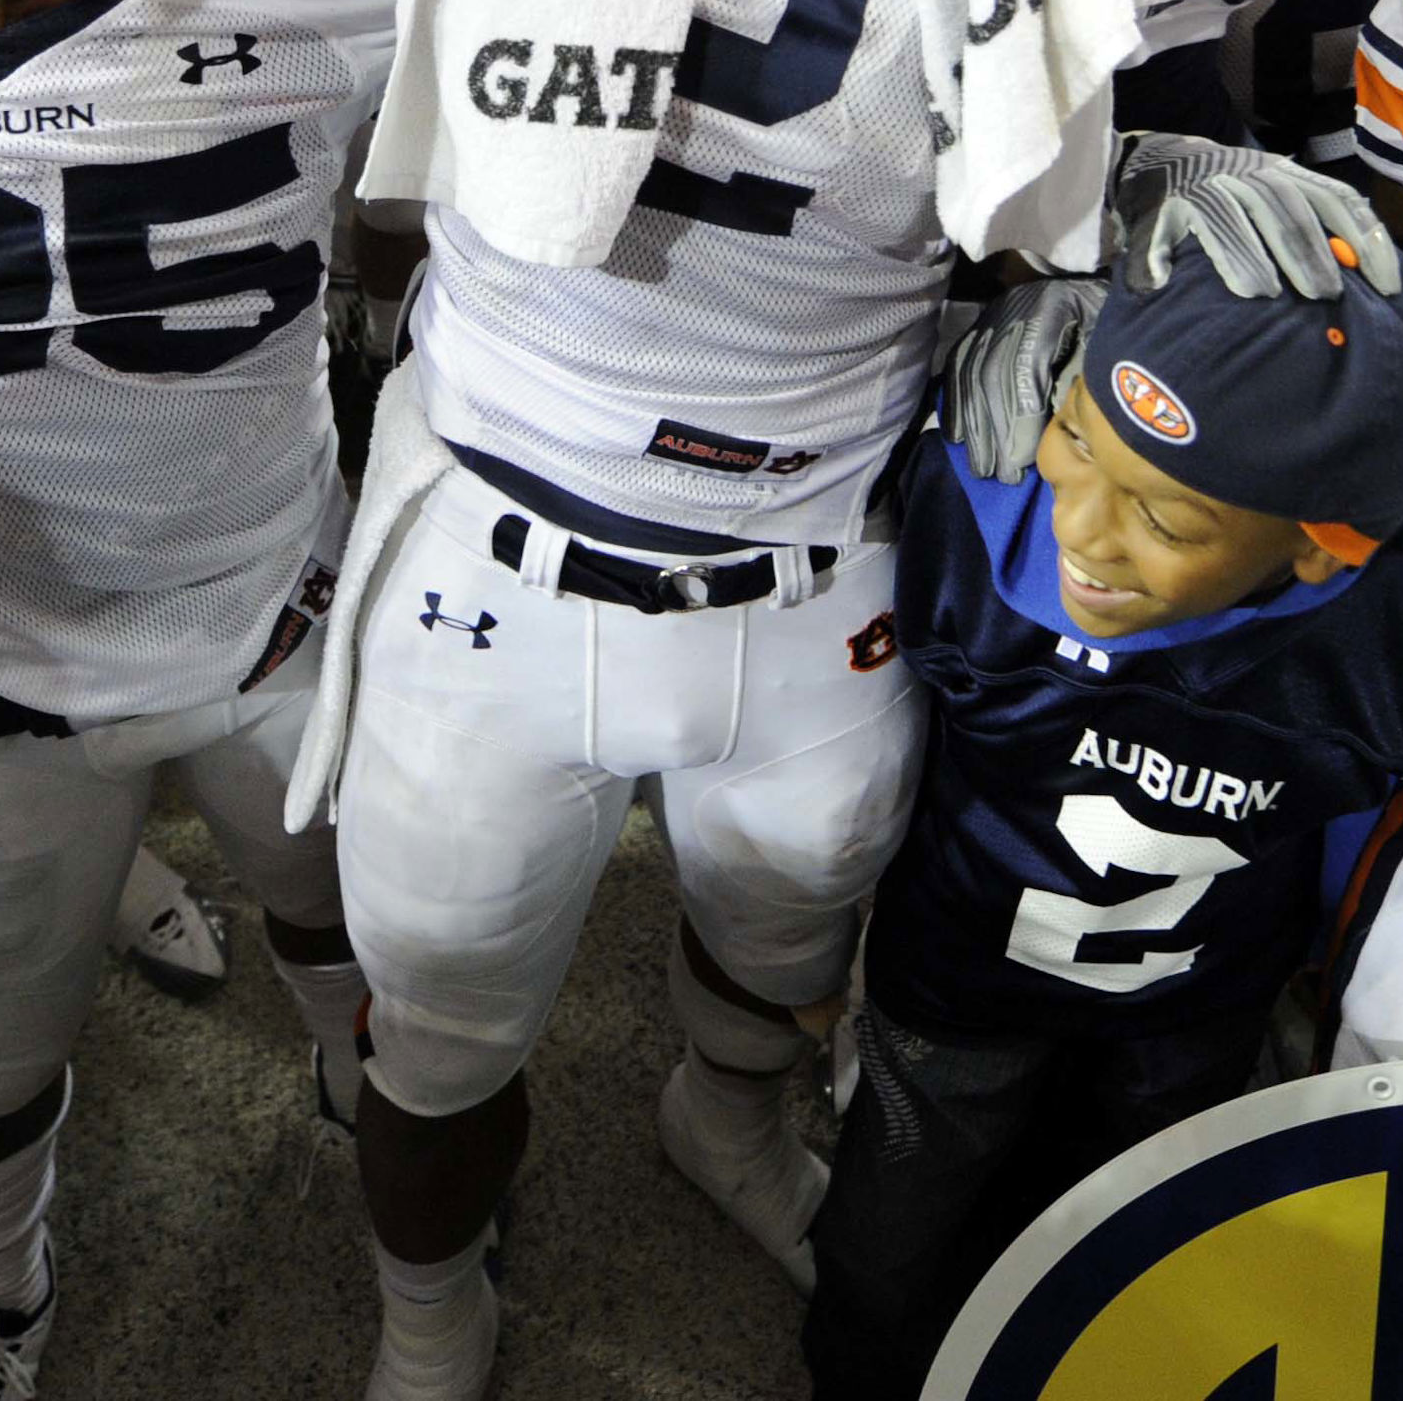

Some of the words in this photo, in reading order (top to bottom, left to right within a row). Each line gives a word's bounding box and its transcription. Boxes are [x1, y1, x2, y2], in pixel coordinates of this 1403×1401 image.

[467, 38, 682, 130] GAT
[656, 433, 763, 466] AUBURN
[1069, 727, 1286, 823] AUBURN
[1004, 793, 1252, 994] 2
